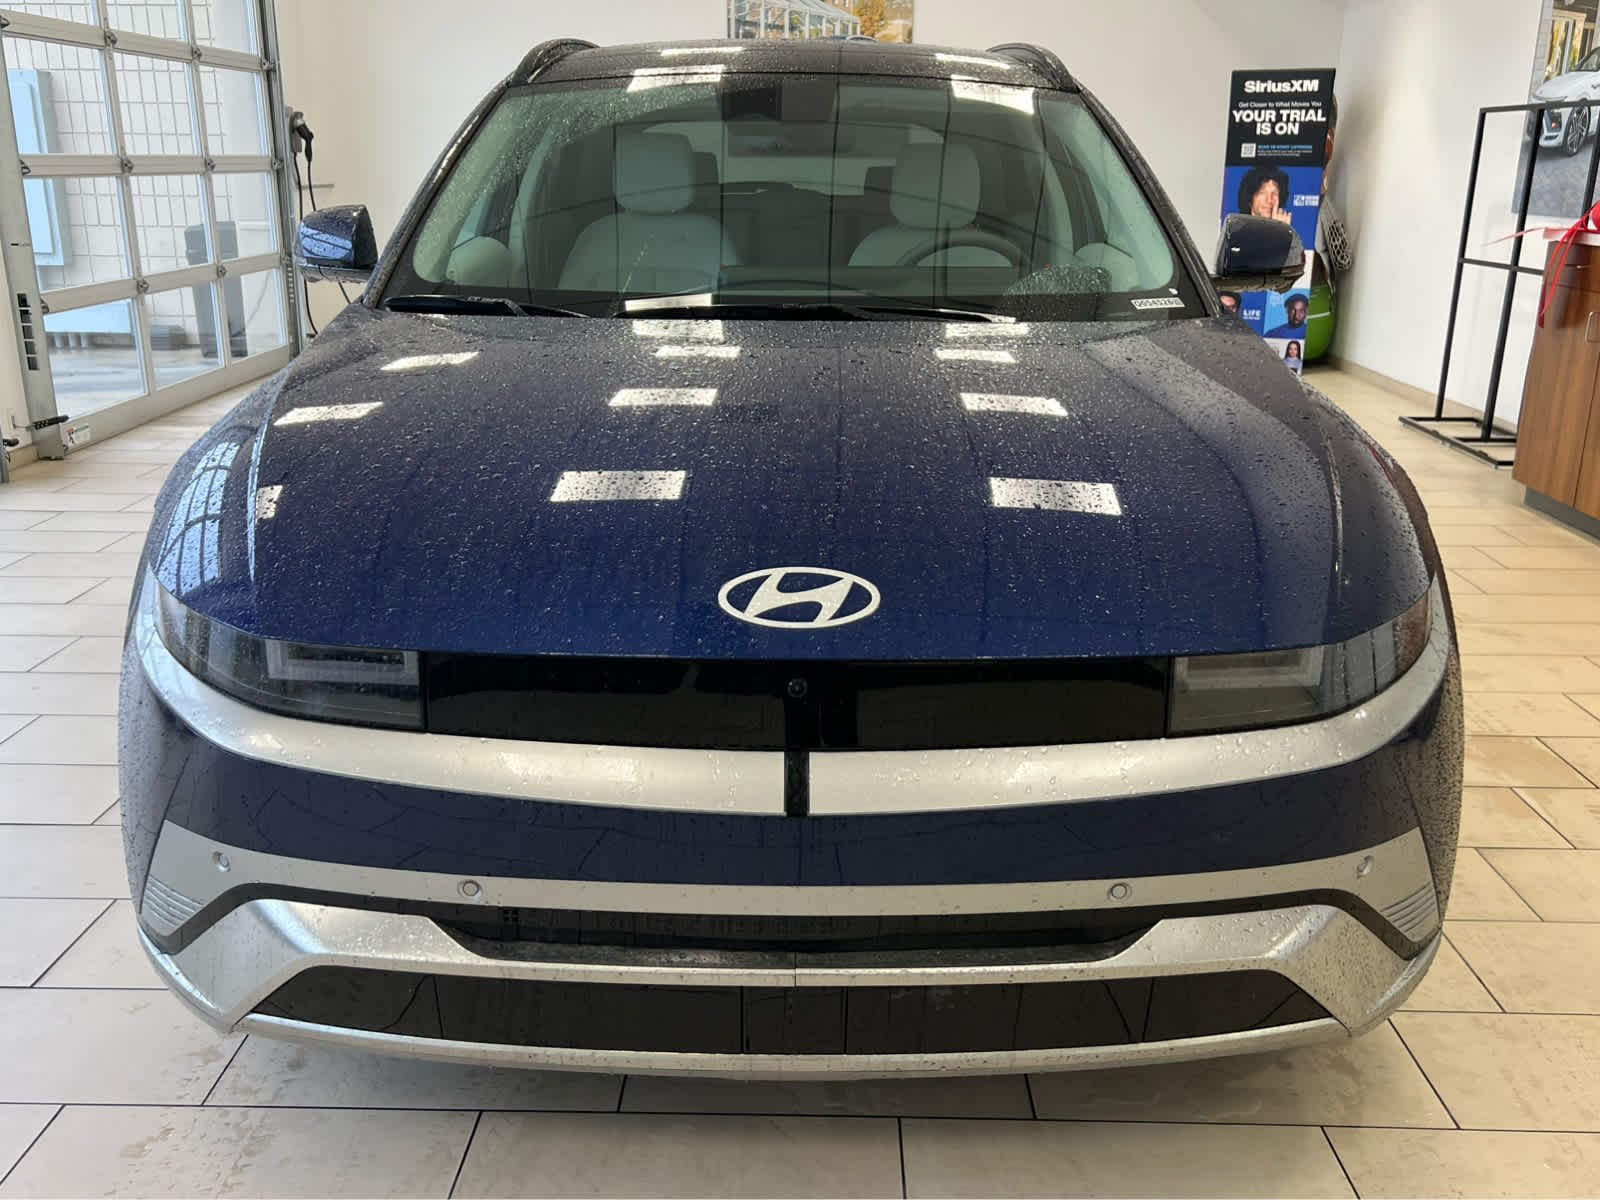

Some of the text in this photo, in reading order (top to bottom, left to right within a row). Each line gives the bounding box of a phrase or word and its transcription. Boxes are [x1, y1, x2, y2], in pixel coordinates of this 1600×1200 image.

[1244, 79, 1320, 93] SiriusXM
[1232, 108, 1327, 122] YOUR TRIAL
[1256, 122, 1300, 135] IS ON
[1243, 309, 1261, 317] LIFE
